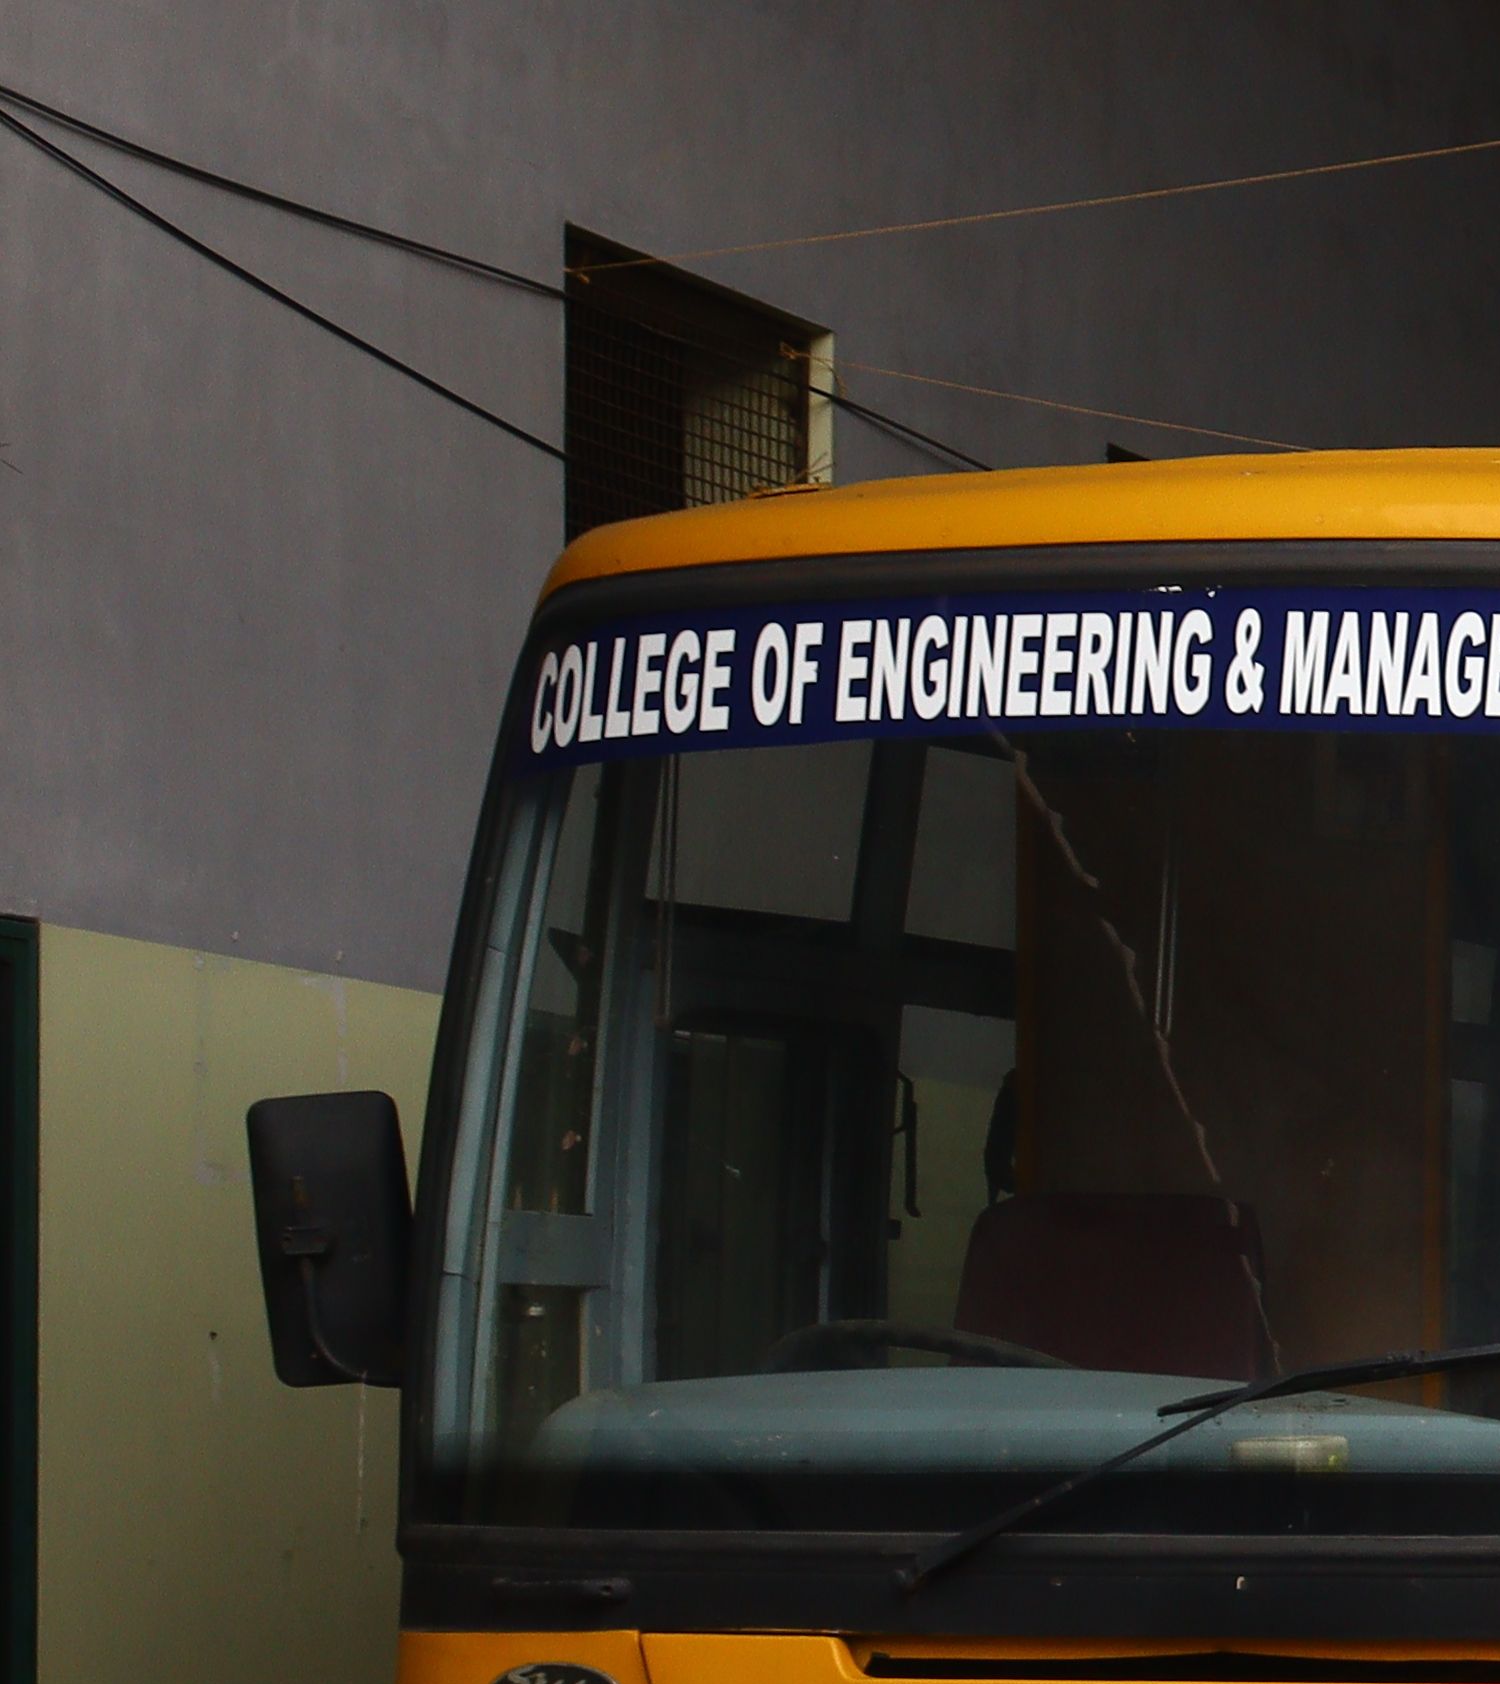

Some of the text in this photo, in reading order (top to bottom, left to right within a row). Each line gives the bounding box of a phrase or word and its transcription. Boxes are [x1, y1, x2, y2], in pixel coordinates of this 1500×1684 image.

[530, 627, 736, 754] COLLEGE
[750, 622, 823, 727] OF
[835, 608, 1214, 721] ENGINEERING
[1225, 608, 1265, 715] &
